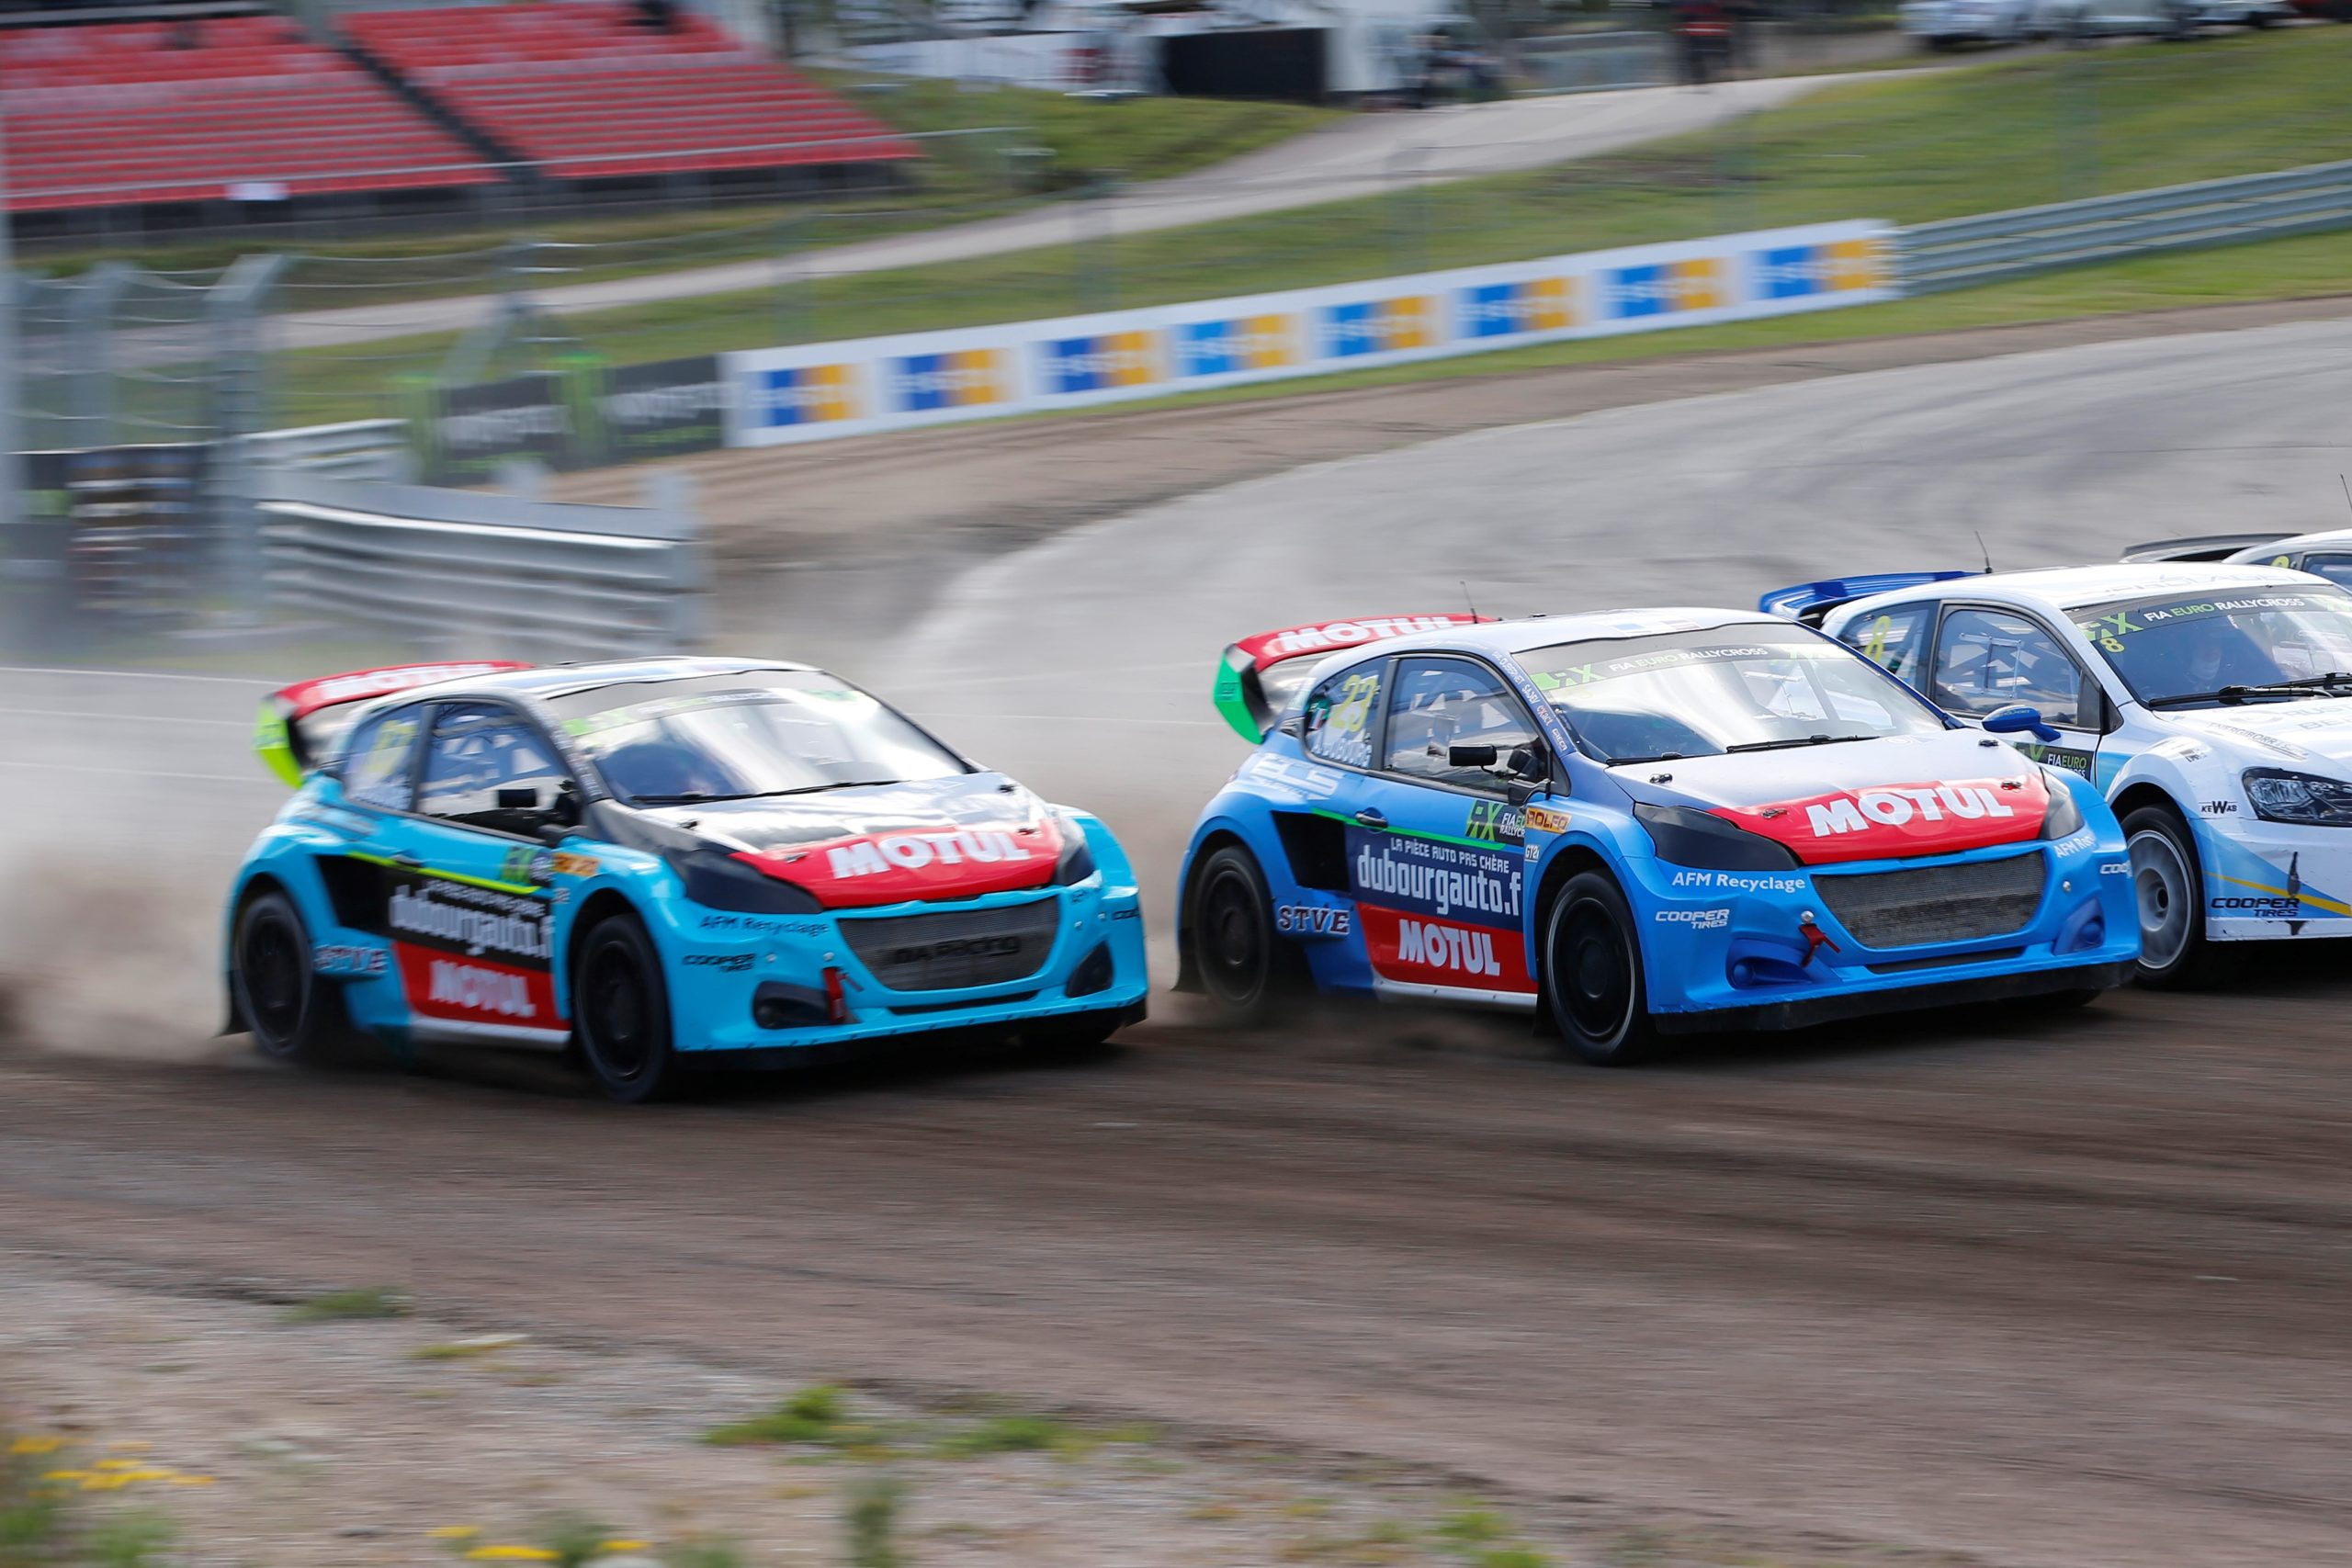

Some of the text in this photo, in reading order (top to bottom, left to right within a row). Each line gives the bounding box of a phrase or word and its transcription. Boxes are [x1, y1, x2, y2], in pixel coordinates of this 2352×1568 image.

[2143, 611, 2173, 623] FIA
[2172, 603, 2216, 617] EURO
[2215, 597, 2305, 611] RALLYCROSS
[2100, 637, 2125, 653] 8
[1609, 655, 1635, 672] FIA
[1634, 653, 1679, 668] EURO
[1678, 648, 1769, 661] RALLYCROSS
[1804, 787, 2014, 838] MOTUL
[827, 831, 1031, 879] MOTUL
[1390, 837, 1510, 874] LA PIÈCE AUTO PAS CHÈRE
[1672, 872, 1806, 894] AFM Recyclage
[2211, 897, 2301, 908] COOPER
[2254, 908, 2299, 917] TIRES
[1278, 905, 1351, 935] STVE
[1656, 908, 1730, 922] COOPER
[1690, 919, 1728, 929] TIRES
[1398, 919, 1500, 976] MOTUL
